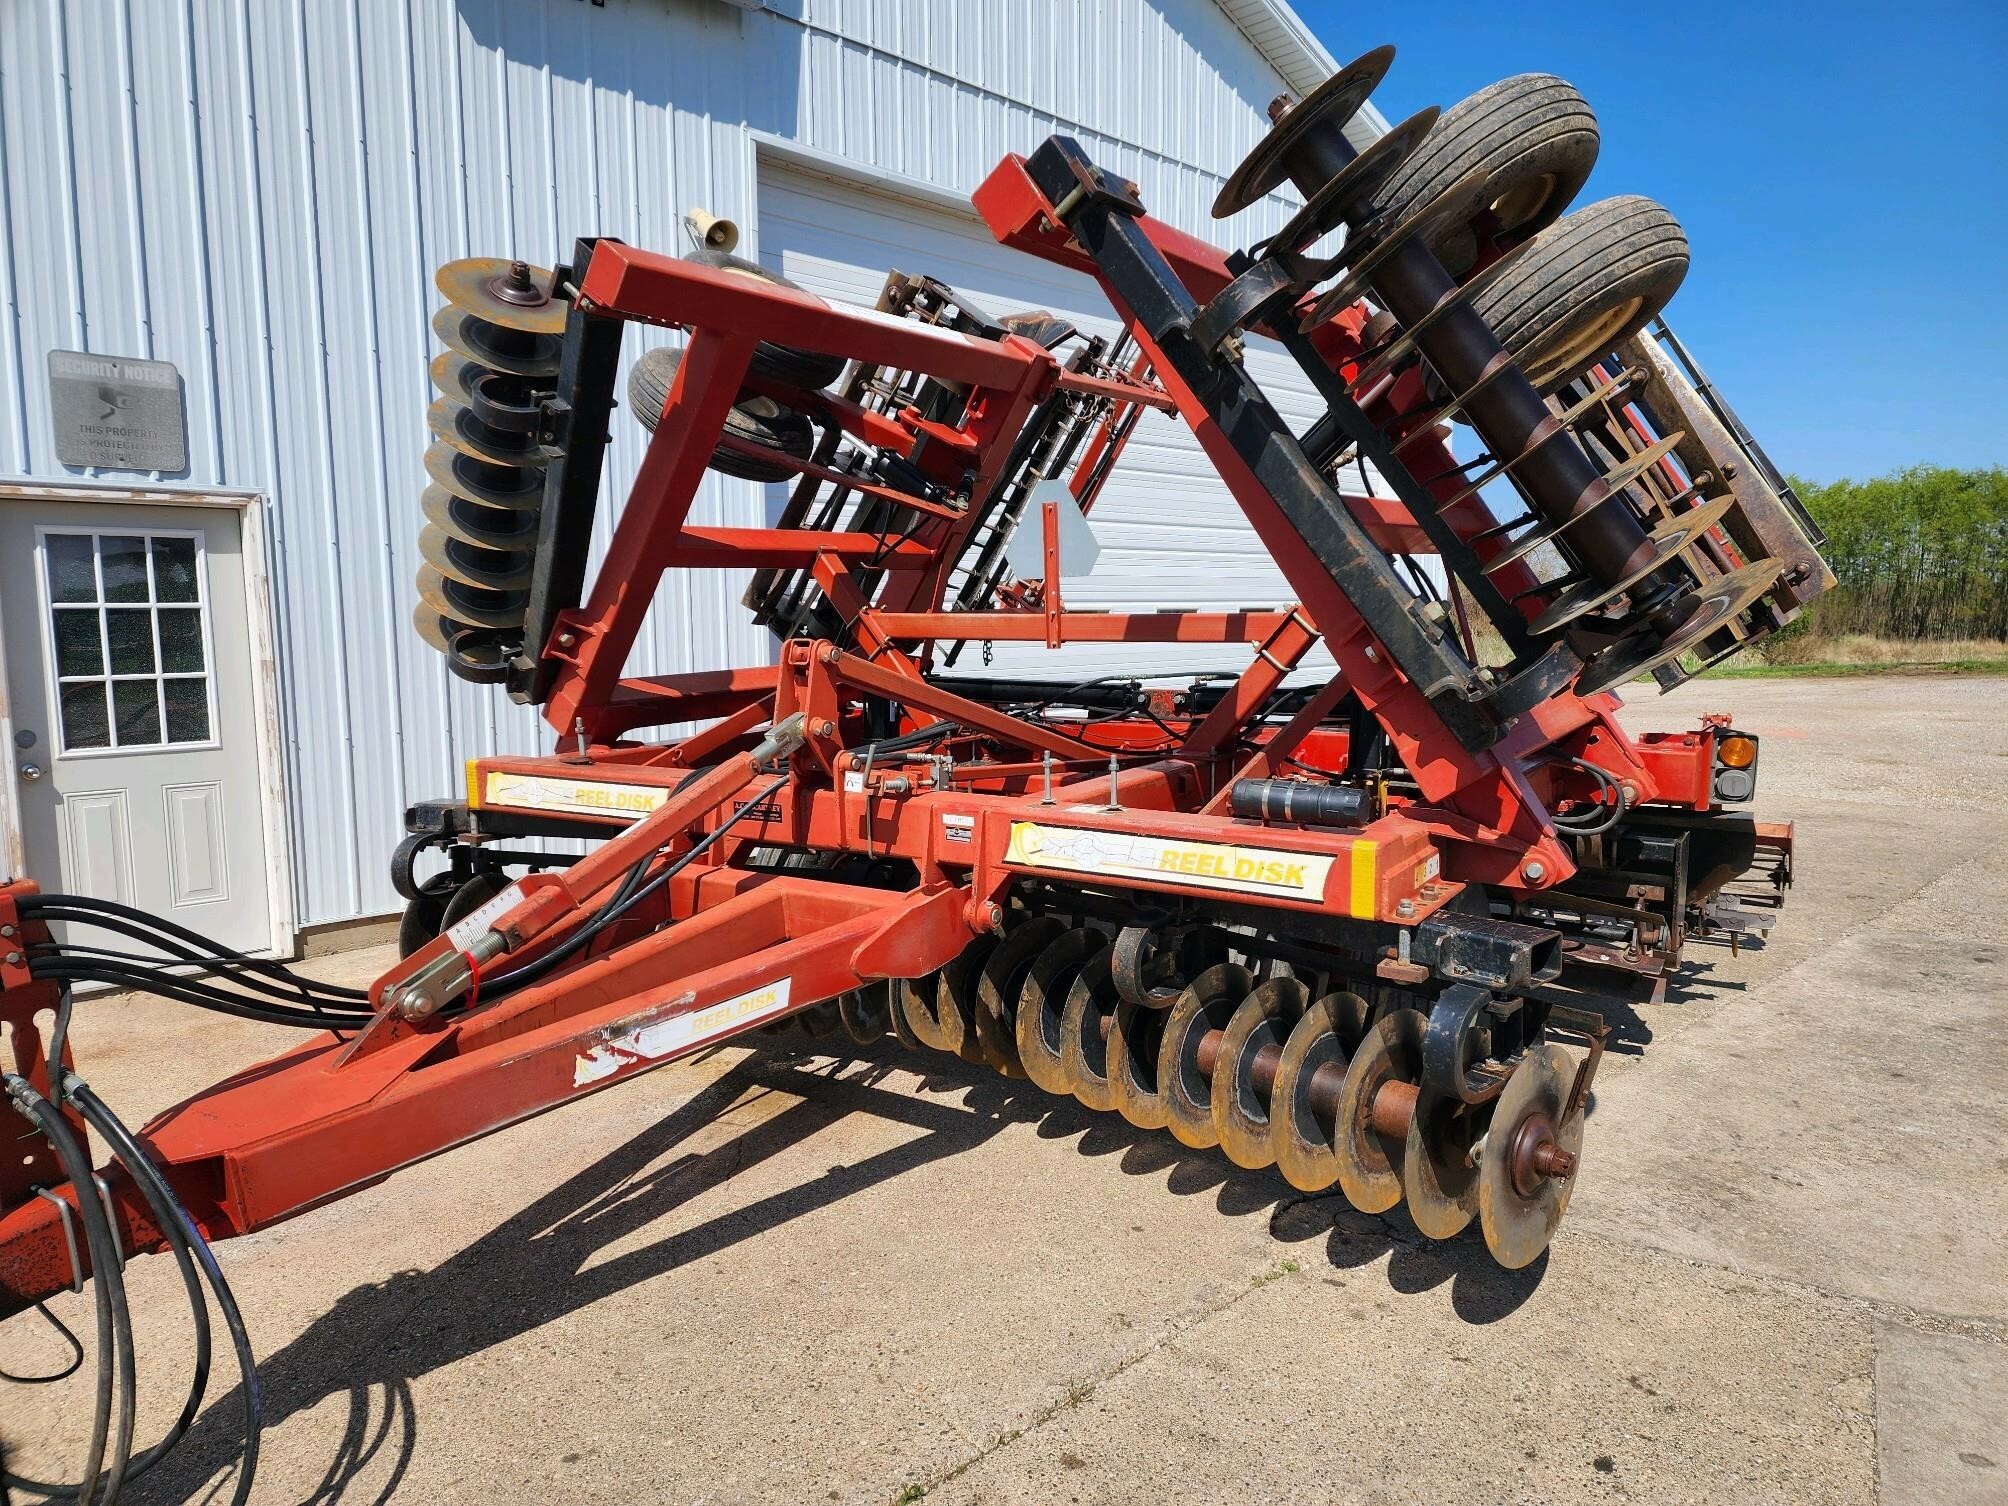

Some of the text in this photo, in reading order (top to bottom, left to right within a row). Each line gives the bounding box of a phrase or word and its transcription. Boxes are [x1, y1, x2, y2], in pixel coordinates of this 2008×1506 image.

[56, 358, 172, 384] SECURITY NOTICE
[80, 425, 159, 439] THIS PROPERTY
[575, 788, 656, 811] REEL DISK
[1158, 850, 1307, 886] REEL DISK
[691, 990, 777, 1032] REEL DISK
